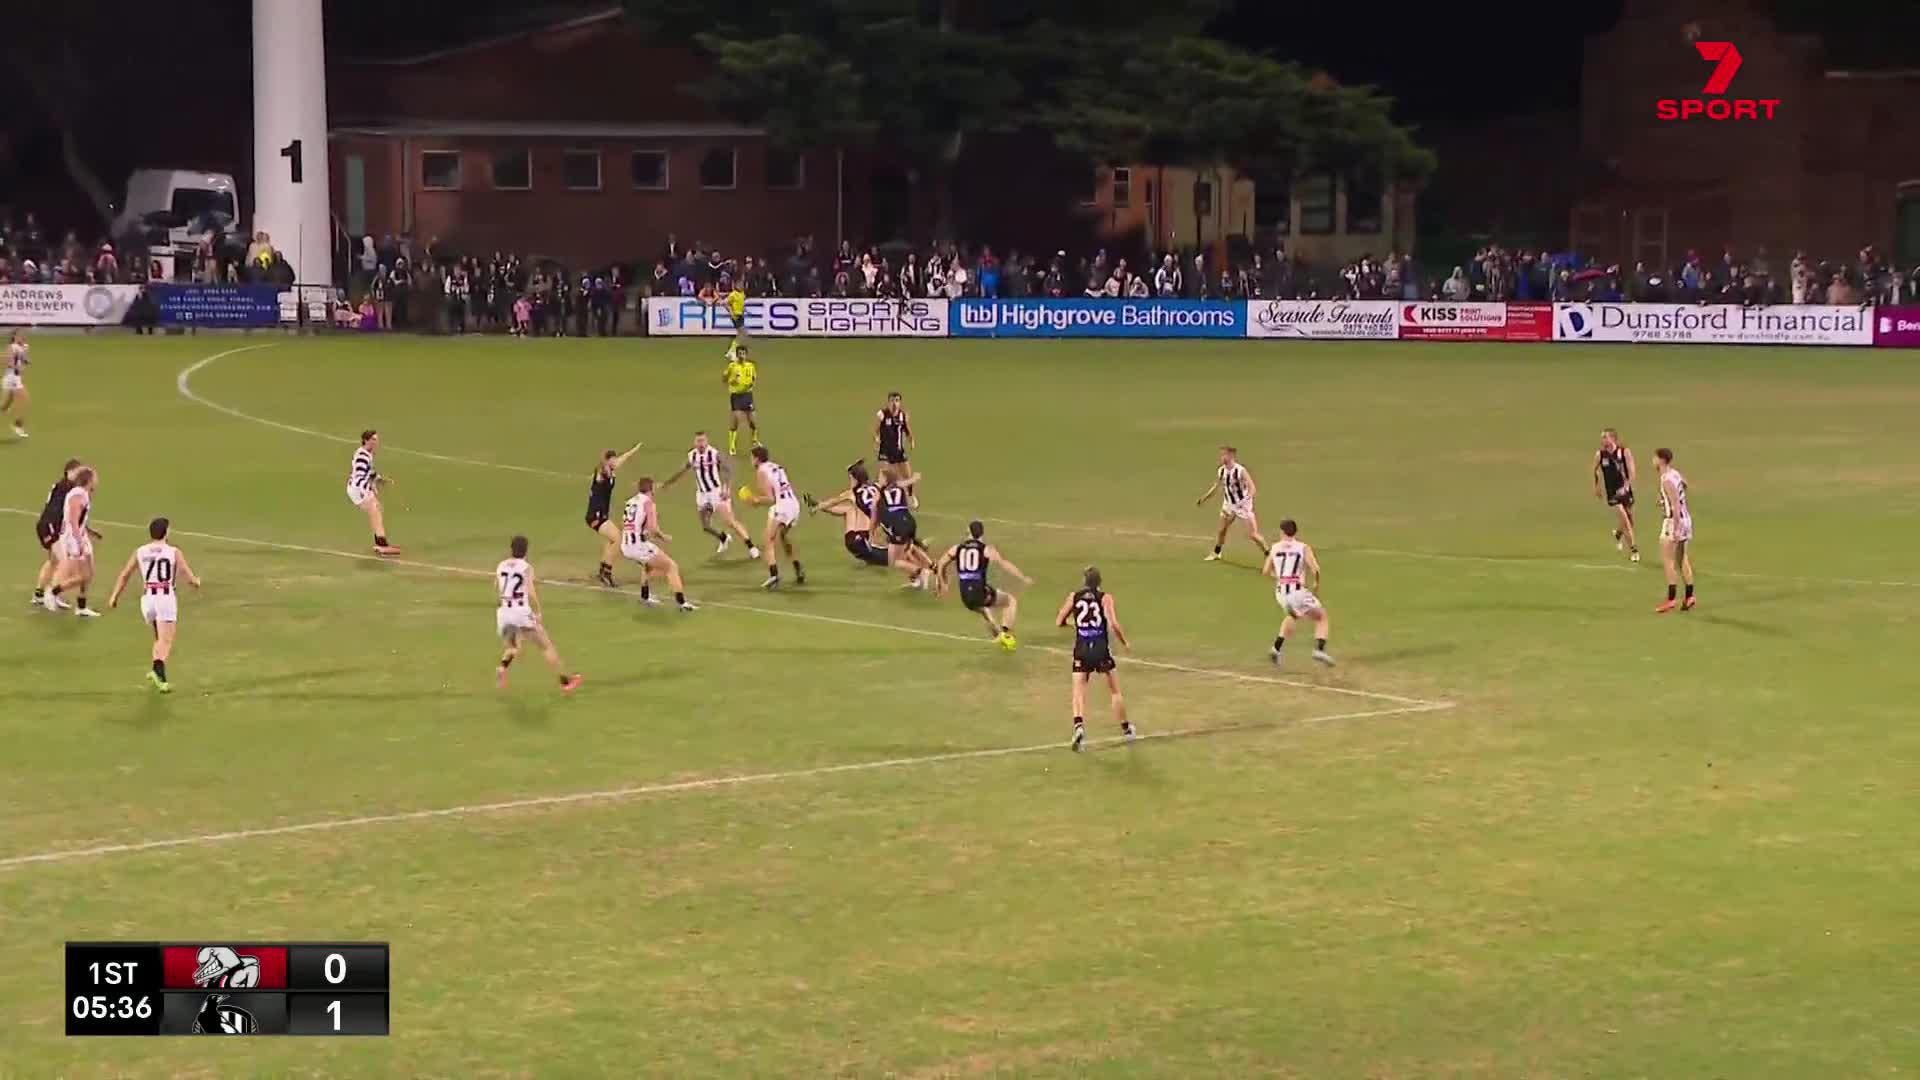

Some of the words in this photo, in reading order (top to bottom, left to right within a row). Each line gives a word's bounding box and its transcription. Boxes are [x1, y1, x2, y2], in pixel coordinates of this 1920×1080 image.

[280, 139, 302, 184] 1
[2, 289, 64, 300] ANDREWS
[17, 301, 75, 312] BREWERY
[680, 301, 799, 331] REES
[807, 302, 929, 317] SPORTS
[1002, 304, 1116, 330] Highgrove
[1122, 305, 1234, 326] Bathrooms
[1257, 301, 1326, 324] Seaside
[1327, 304, 1393, 324] Funerals
[1420, 307, 1457, 321] KISS
[1601, 305, 1728, 330] Dunsford
[1742, 307, 1864, 332] Financial
[807, 317, 940, 332] LIGHTING
[884, 488, 902, 505] 17
[143, 557, 171, 582] 70
[959, 548, 979, 571] 10
[1276, 551, 1301, 578] 77
[500, 572, 524, 598] 72
[1076, 600, 1102, 627] 23
